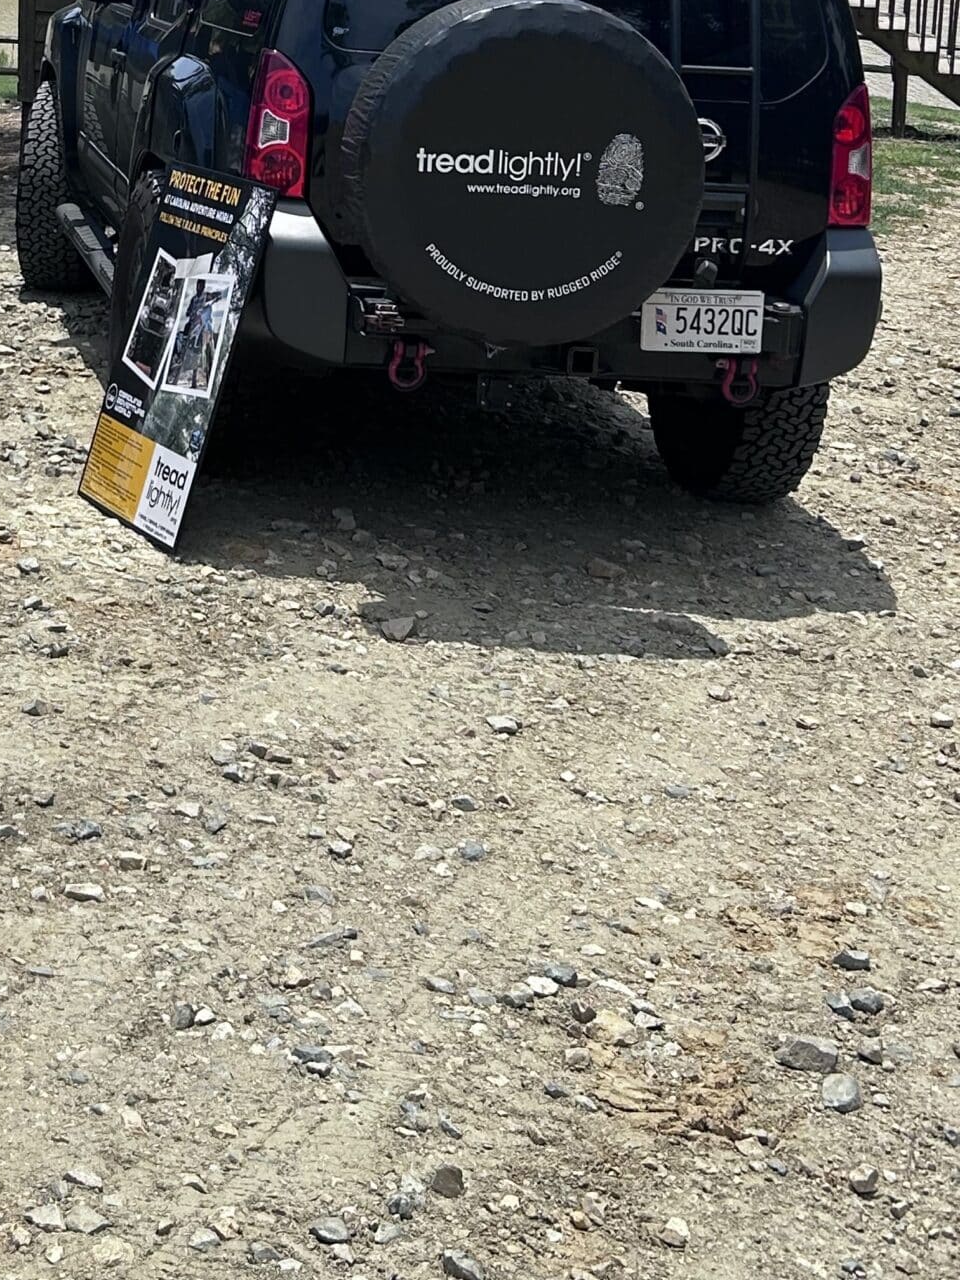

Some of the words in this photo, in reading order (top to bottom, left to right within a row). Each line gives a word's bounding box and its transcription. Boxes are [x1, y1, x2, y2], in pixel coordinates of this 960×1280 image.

[416, 147, 495, 174] tread
[169, 170, 206, 196] PROTECT
[204, 179, 223, 202] THE
[220, 184, 242, 207] FUN
[466, 183, 581, 199] www.treadlightly.org
[170, 195, 191, 210] CAROLINA
[190, 201, 217, 220] ADVENTURE
[215, 209, 235, 225] WORLD
[425, 243, 467, 282] PROUDLY
[465, 276, 529, 301] SUPPORTED
[531, 289, 545, 301] BY
[547, 275, 591, 299] RUGGED
[681, 295, 699, 304] GOD
[700, 296, 713, 304] WE
[675, 307, 759, 336] 5432QC
[670, 339, 695, 348] South
[696, 339, 733, 349] Carolina
[153, 456, 189, 491] tread
